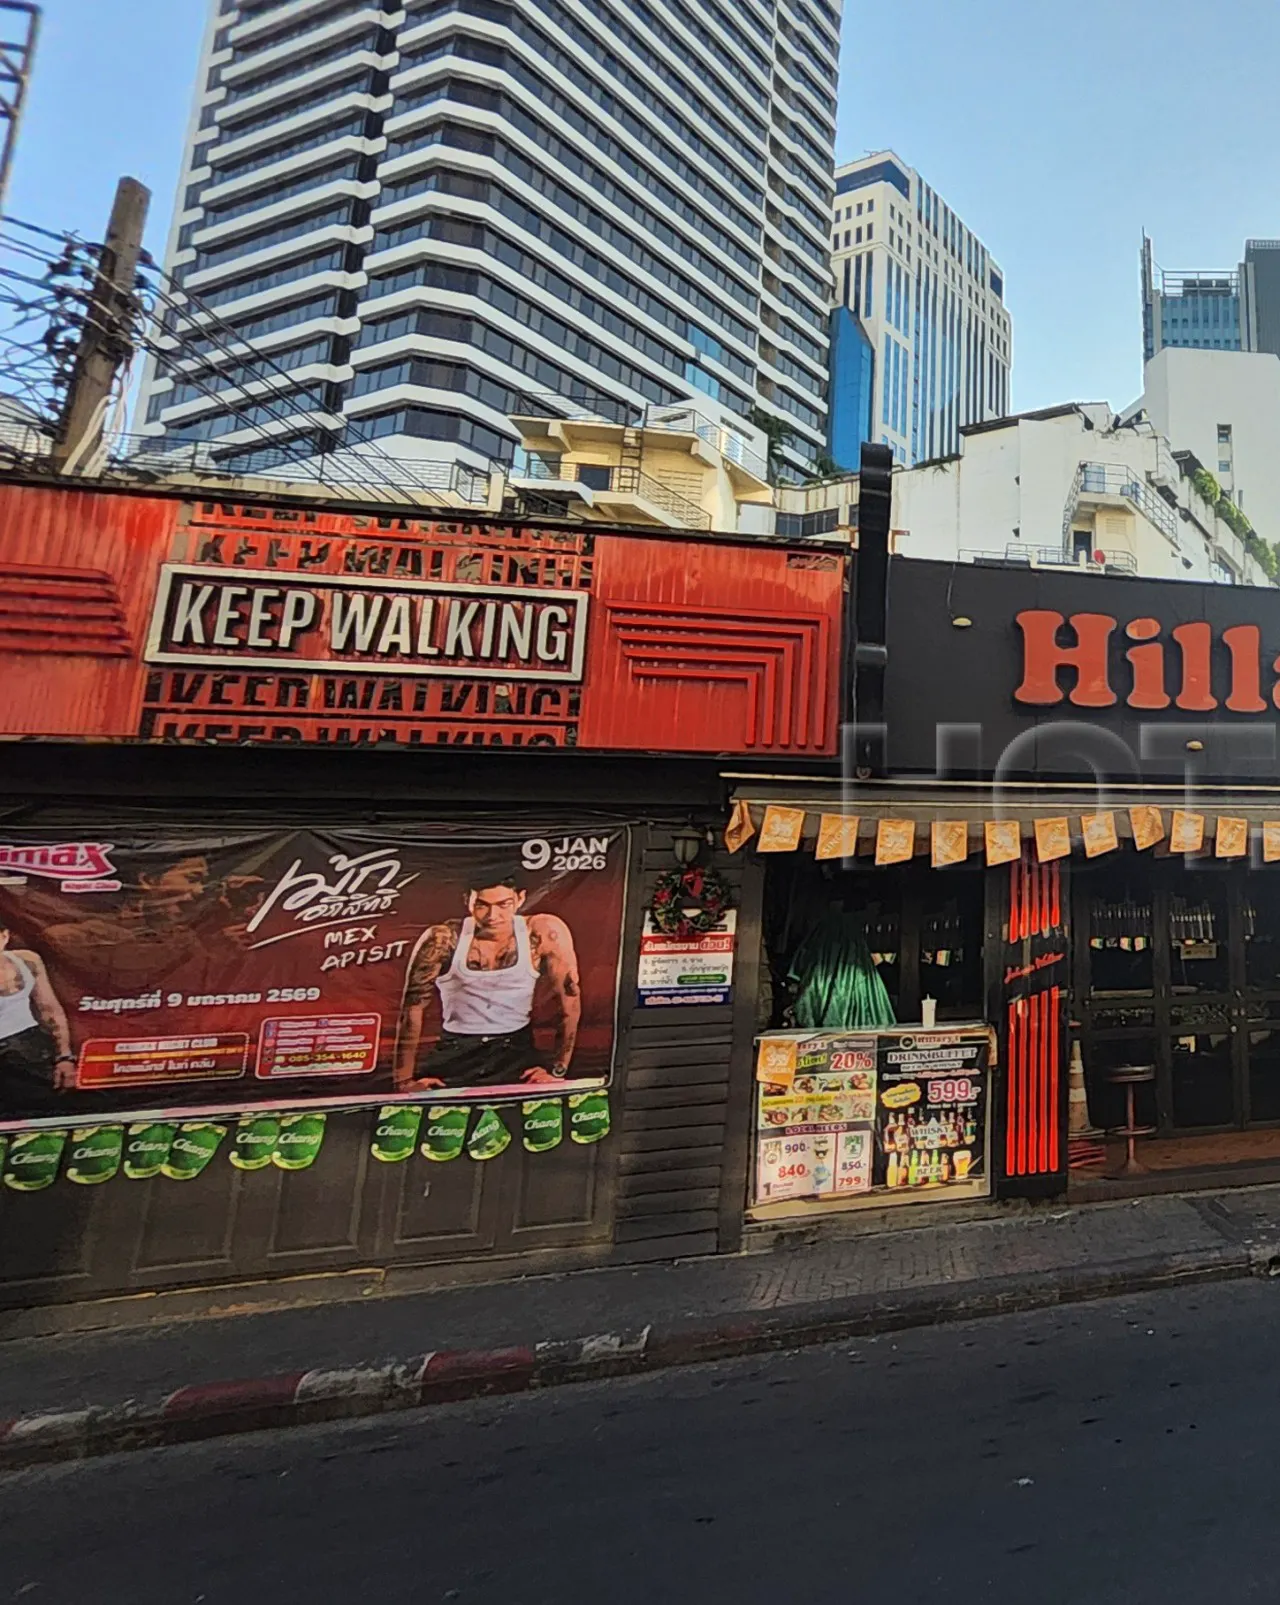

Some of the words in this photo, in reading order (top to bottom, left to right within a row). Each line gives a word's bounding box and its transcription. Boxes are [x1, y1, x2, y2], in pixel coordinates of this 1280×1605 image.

[171, 582, 315, 649] KEEP
[330, 592, 569, 662] WALKING
[521, 838, 551, 870] 9
[554, 837, 609, 854] JAN
[551, 854, 607, 871] 2026
[324, 924, 377, 949] MEX
[320, 939, 410, 972] APISIT
[78, 989, 162, 1014] วันศุกร์ที่
[167, 992, 183, 1008] 9
[187, 992, 261, 1007] มกราคม
[266, 987, 321, 1003] 2569
[831, 1051, 873, 1071] 20%
[928, 1079, 982, 1103] 599.-
[524, 1118, 561, 1131] Chang
[571, 1109, 608, 1124] Chang
[236, 1132, 278, 1146] Chang
[278, 1132, 321, 1146] Chang
[376, 1125, 416, 1138] Chang
[428, 1125, 466, 1137] Chang
[471, 1119, 500, 1142] hang
[73, 1147, 119, 1159] Chang
[128, 1140, 171, 1152] Chang
[172, 1138, 209, 1158] Chang
[10, 1152, 60, 1166] Chang
